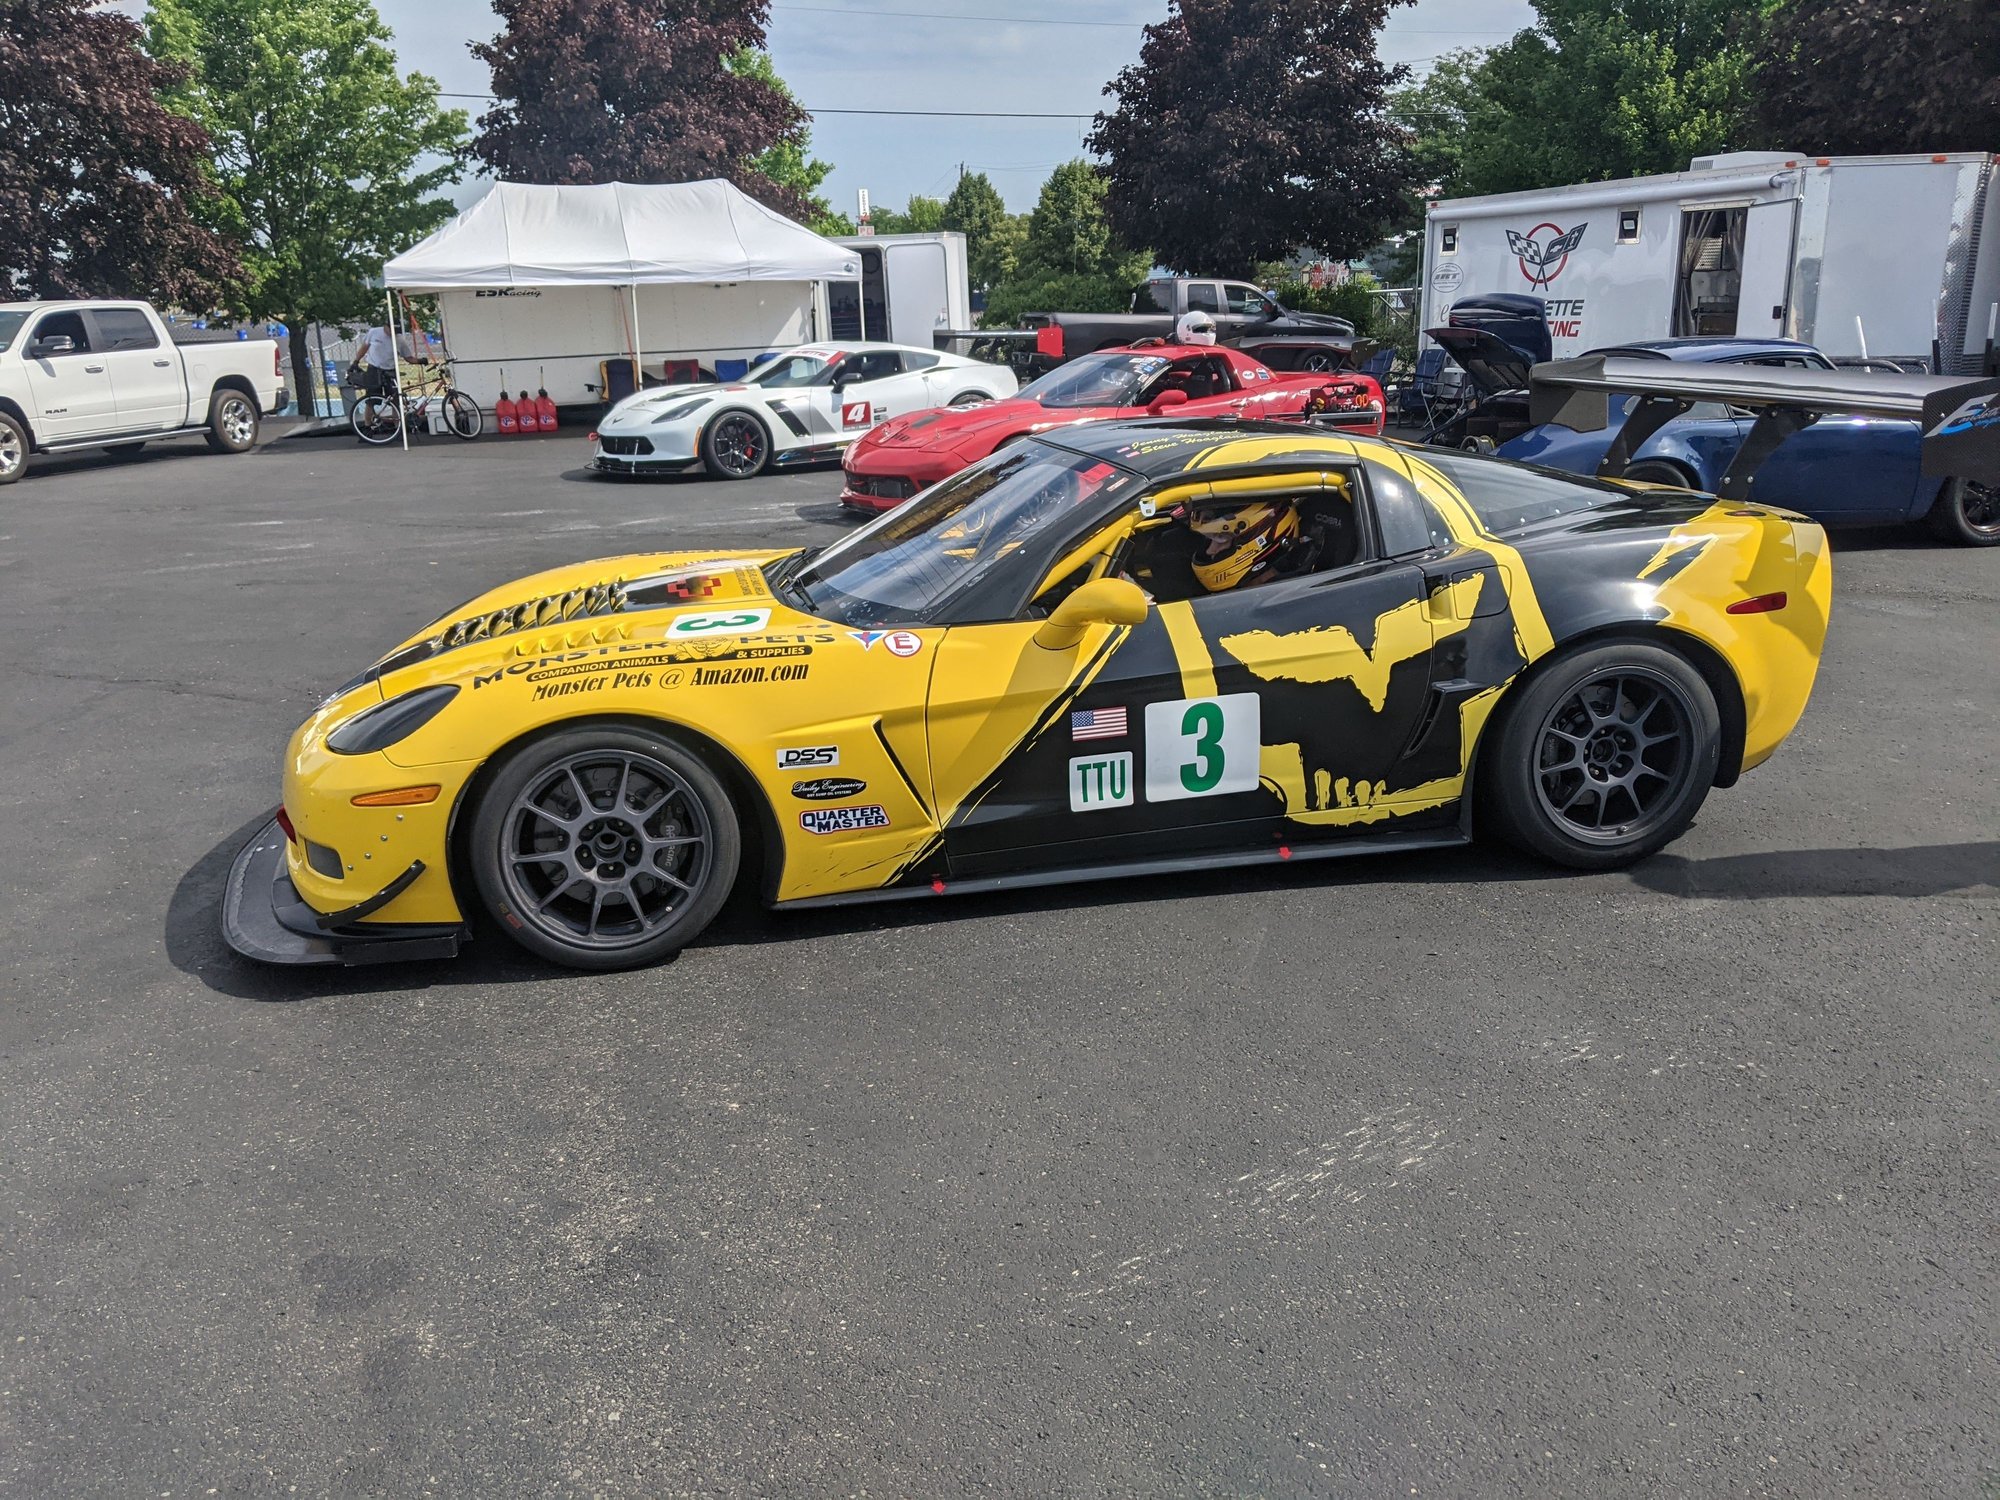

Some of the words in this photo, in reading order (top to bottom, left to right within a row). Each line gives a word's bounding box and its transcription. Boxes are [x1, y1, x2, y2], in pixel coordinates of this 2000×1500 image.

[1545, 299, 1585, 316] ETTE
[1547, 320, 1582, 337] ING
[847, 403, 866, 422] 4
[1140, 442, 1179, 454] Steve
[1314, 513, 1342, 528] COBRA
[893, 635, 913, 649] E
[474, 641, 669, 690] MONSTER
[740, 633, 836, 644] PETS
[530, 661, 609, 681] COMPANION
[611, 655, 669, 670] ANIMALS
[736, 650, 748, 659] &
[750, 646, 806, 658] SUPPLIES
[532, 676, 609, 702] Monster
[612, 670, 653, 689] Pets
[659, 668, 685, 690] @
[690, 663, 810, 686] Amazon.com
[785, 747, 837, 764] DSS
[1076, 759, 1126, 803] TTU
[1180, 701, 1225, 793] 3
[802, 806, 881, 828] QUARTER
[817, 815, 886, 833] MASTER
